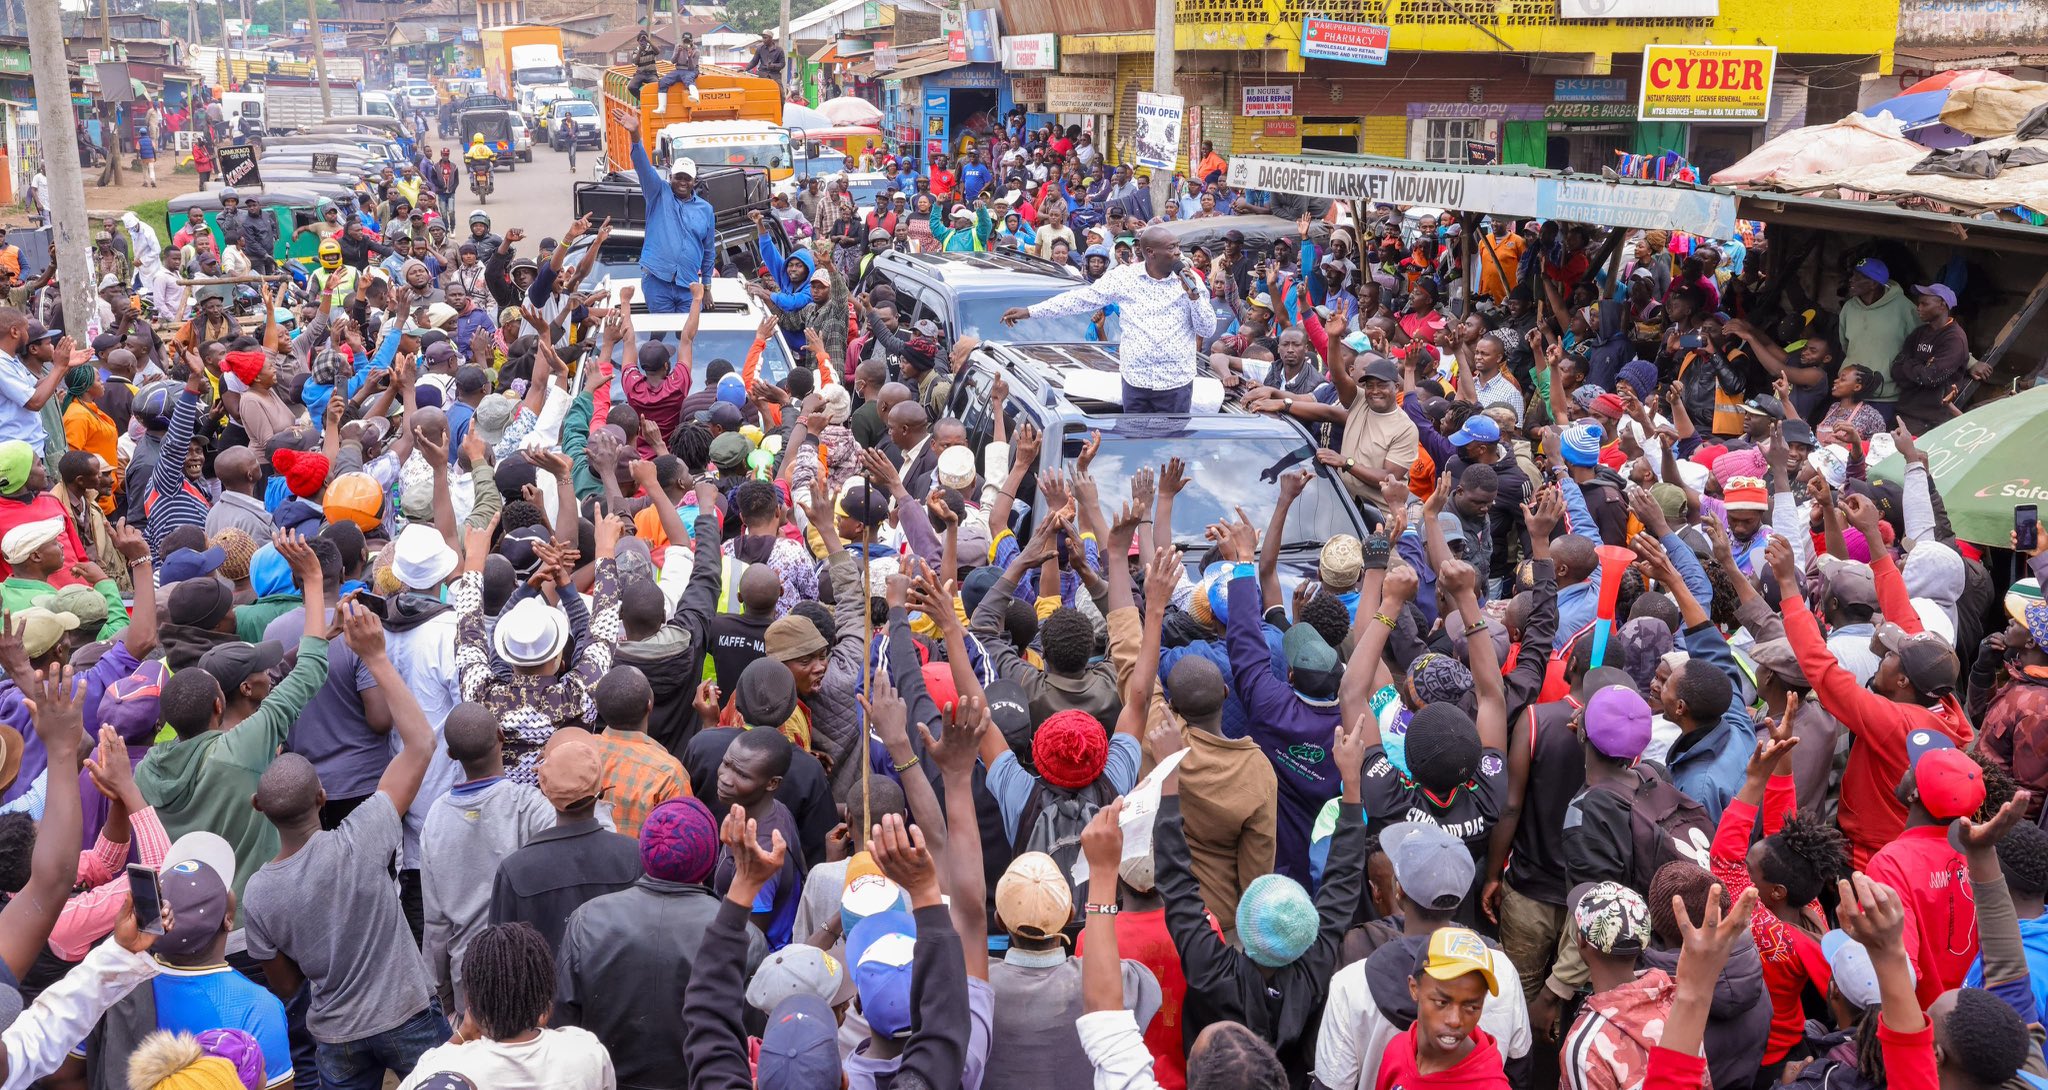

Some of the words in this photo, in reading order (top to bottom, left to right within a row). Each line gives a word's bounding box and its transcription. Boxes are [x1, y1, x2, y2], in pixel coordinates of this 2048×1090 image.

[1357, 26, 1388, 36] CHEMISTS
[1324, 32, 1375, 46] PHARMACY
[1316, 43, 1346, 51] WHOLESALE
[1308, 48, 1338, 57] DISPENSING
[1351, 52, 1383, 61] VETERINARY
[1650, 58, 1763, 90] CYBER
[1138, 105, 1156, 116] NOW
[1158, 108, 1180, 119] OPEN
[1428, 104, 1507, 116] PHOTOCOPY
[1544, 104, 1590, 118] CYBER
[1601, 104, 1638, 117] BARBER
[695, 134, 768, 144] SKYNET
[226, 158, 255, 186] KAREN
[1258, 165, 1324, 194] DAGORETTI
[1328, 174, 1388, 199] MARKET
[1391, 172, 1464, 207] (NDUNYU)
[1556, 204, 1615, 222] DAGORETTI
[1942, 422, 1996, 454] FOR
[718, 635, 746, 648] KAFFE
